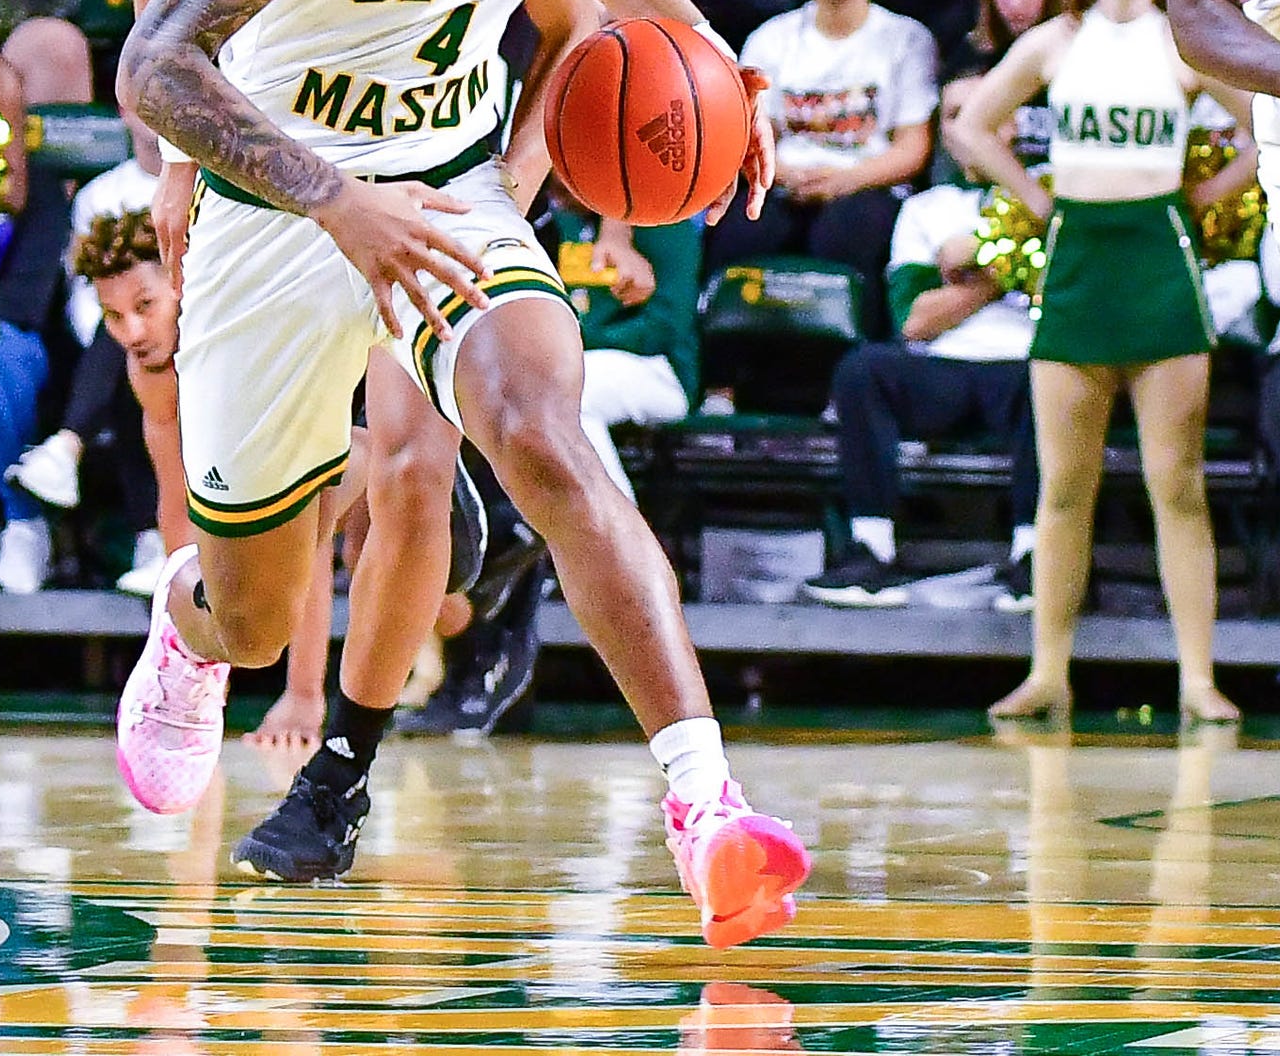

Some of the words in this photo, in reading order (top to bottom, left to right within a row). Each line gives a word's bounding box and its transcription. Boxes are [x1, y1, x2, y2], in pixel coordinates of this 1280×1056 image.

[414, 0, 478, 77] 4
[291, 58, 490, 138] MASON
[1056, 102, 1177, 148] MASON
